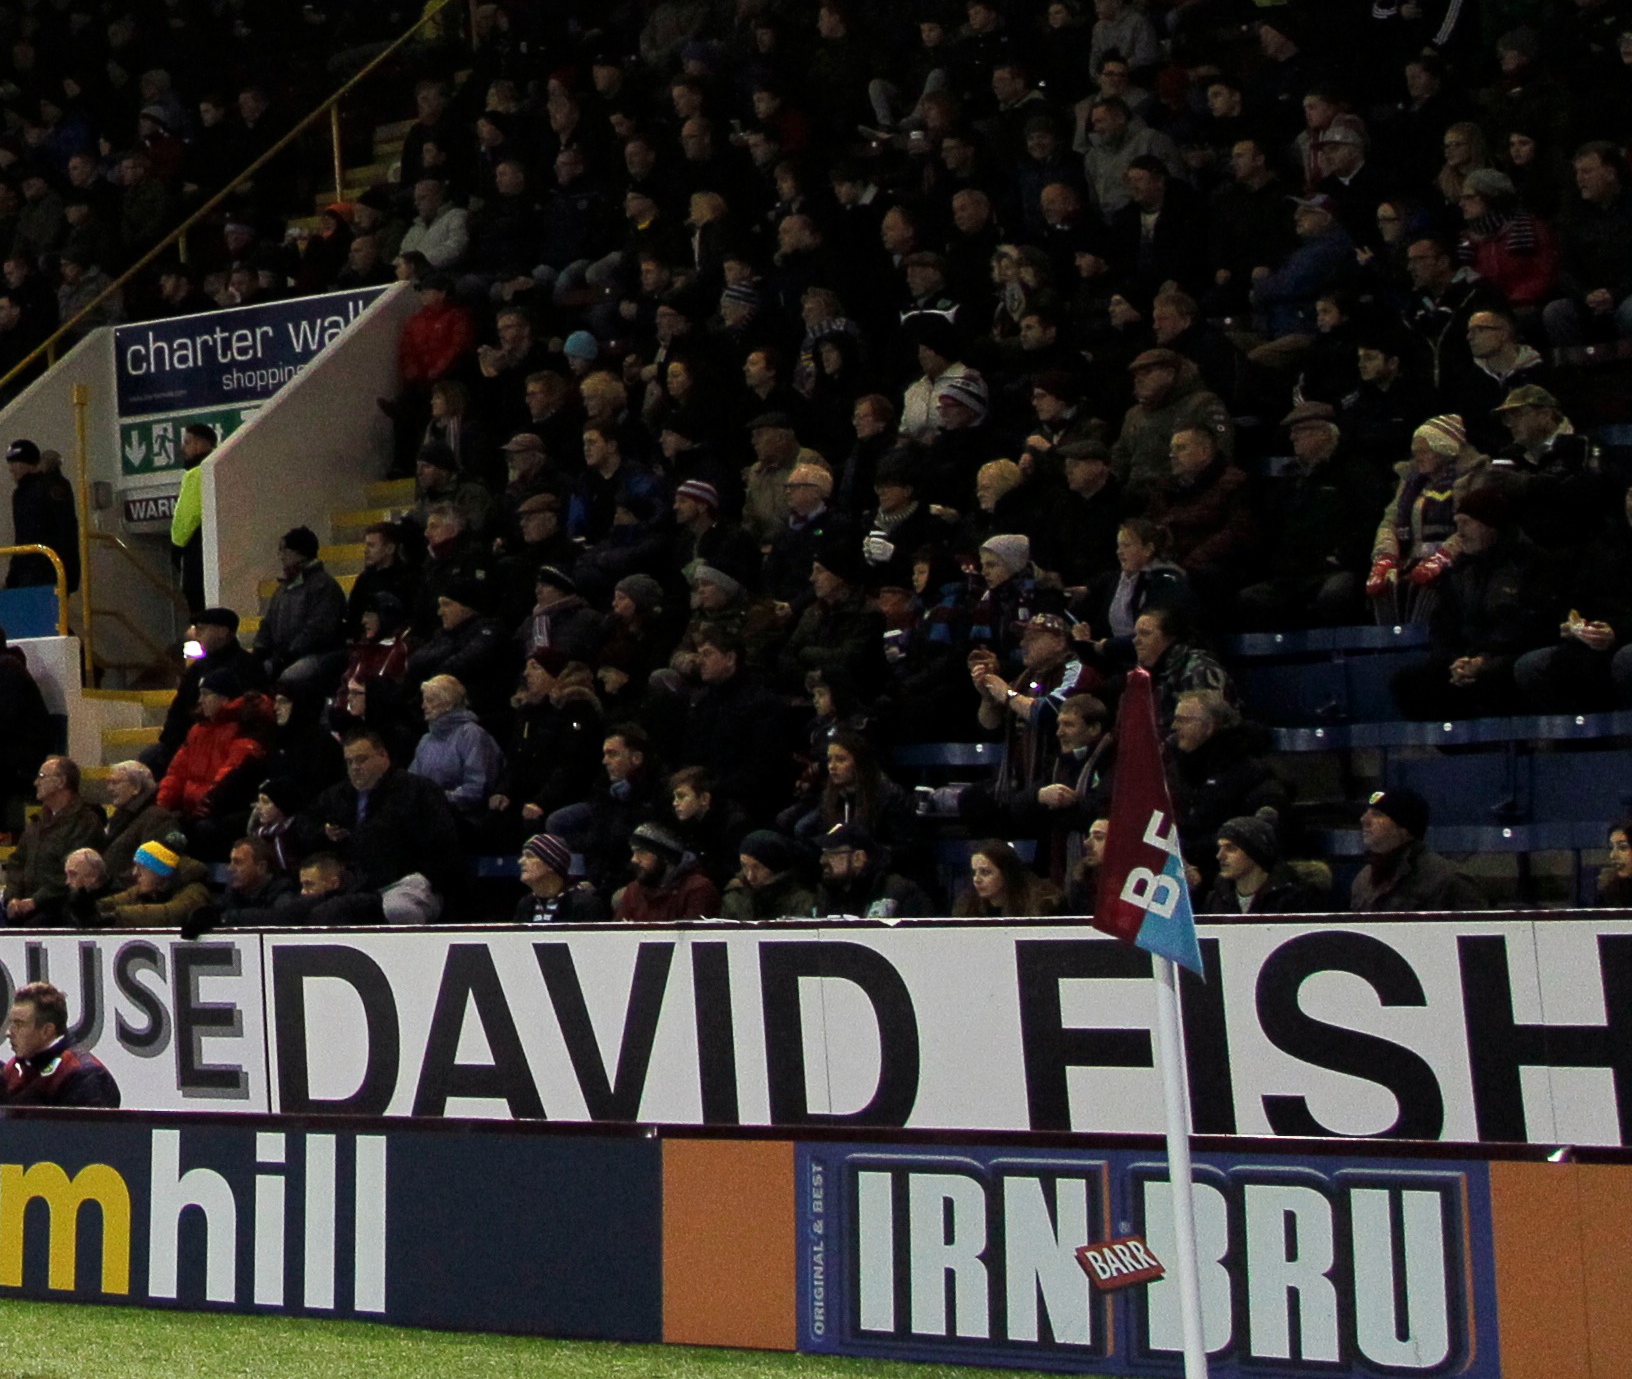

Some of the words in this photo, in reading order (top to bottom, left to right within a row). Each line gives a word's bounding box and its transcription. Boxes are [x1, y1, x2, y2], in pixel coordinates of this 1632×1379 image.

[126, 325, 274, 376] charter
[289, 300, 364, 353] wal
[272, 939, 921, 1128] DAVID
[1014, 928, 1632, 1146] FISH
[812, 1163, 824, 1213] BEST
[813, 1219, 824, 1234] &
[1084, 1240, 1158, 1280] BARR
[813, 1240, 825, 1335] ORIGINAL
[857, 1169, 1092, 1346] IRN
[1144, 1179, 1450, 1369] BRU
